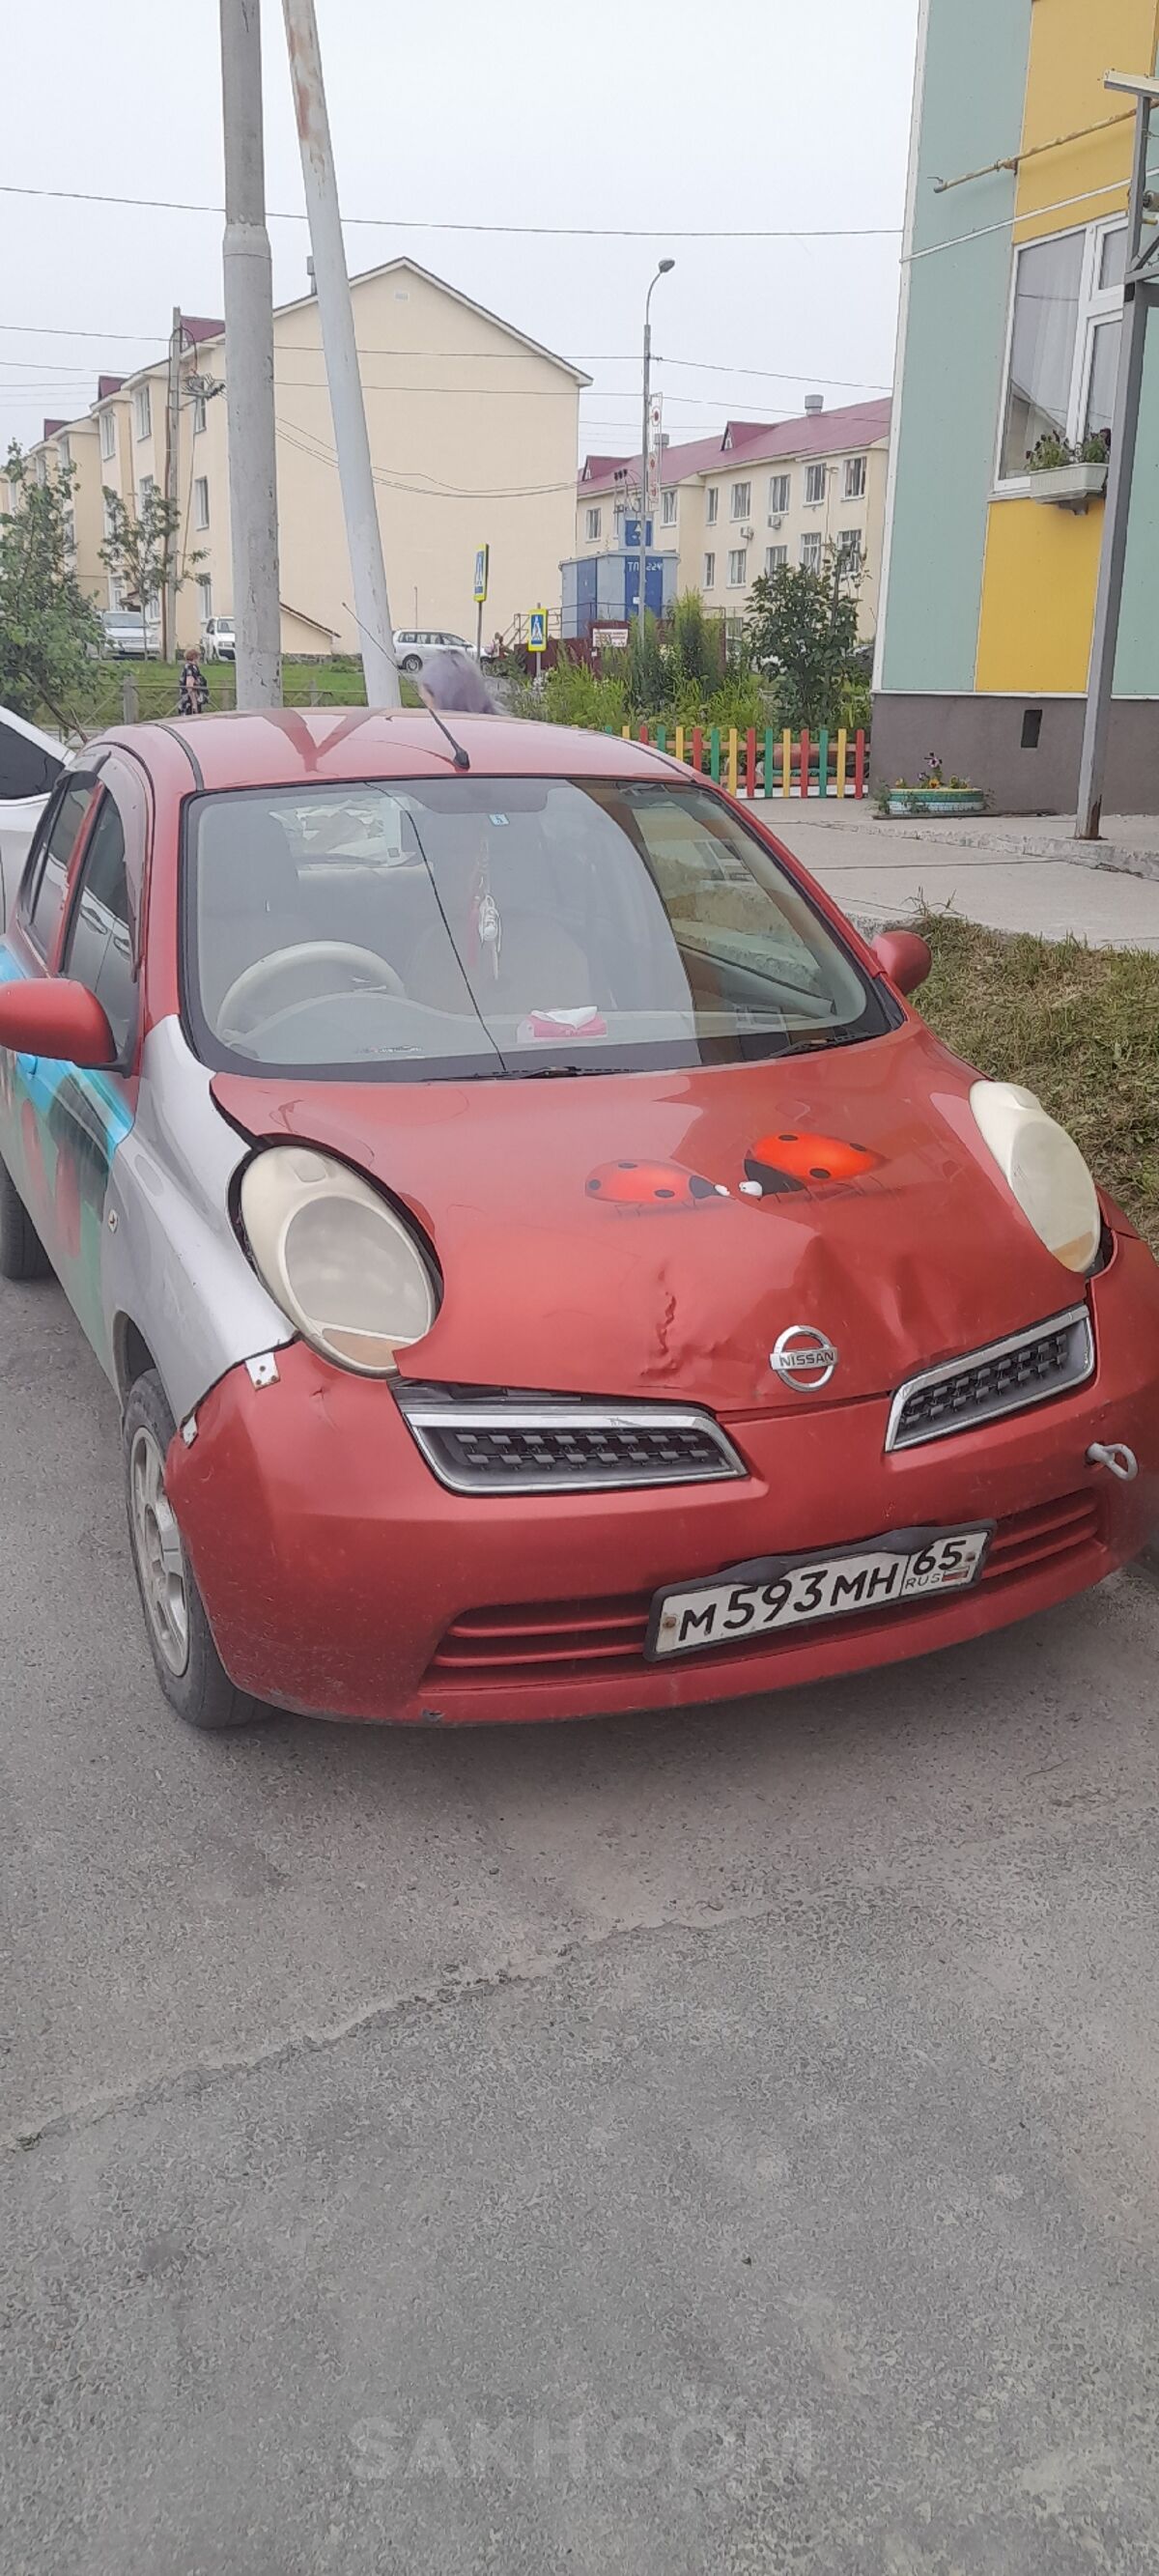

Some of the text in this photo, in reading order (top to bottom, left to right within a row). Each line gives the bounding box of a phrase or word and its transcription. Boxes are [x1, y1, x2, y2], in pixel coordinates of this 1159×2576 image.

[779, 1352, 834, 1367] NISSAN
[912, 1540, 967, 1575] 65
[905, 1573, 941, 1591] RUS
